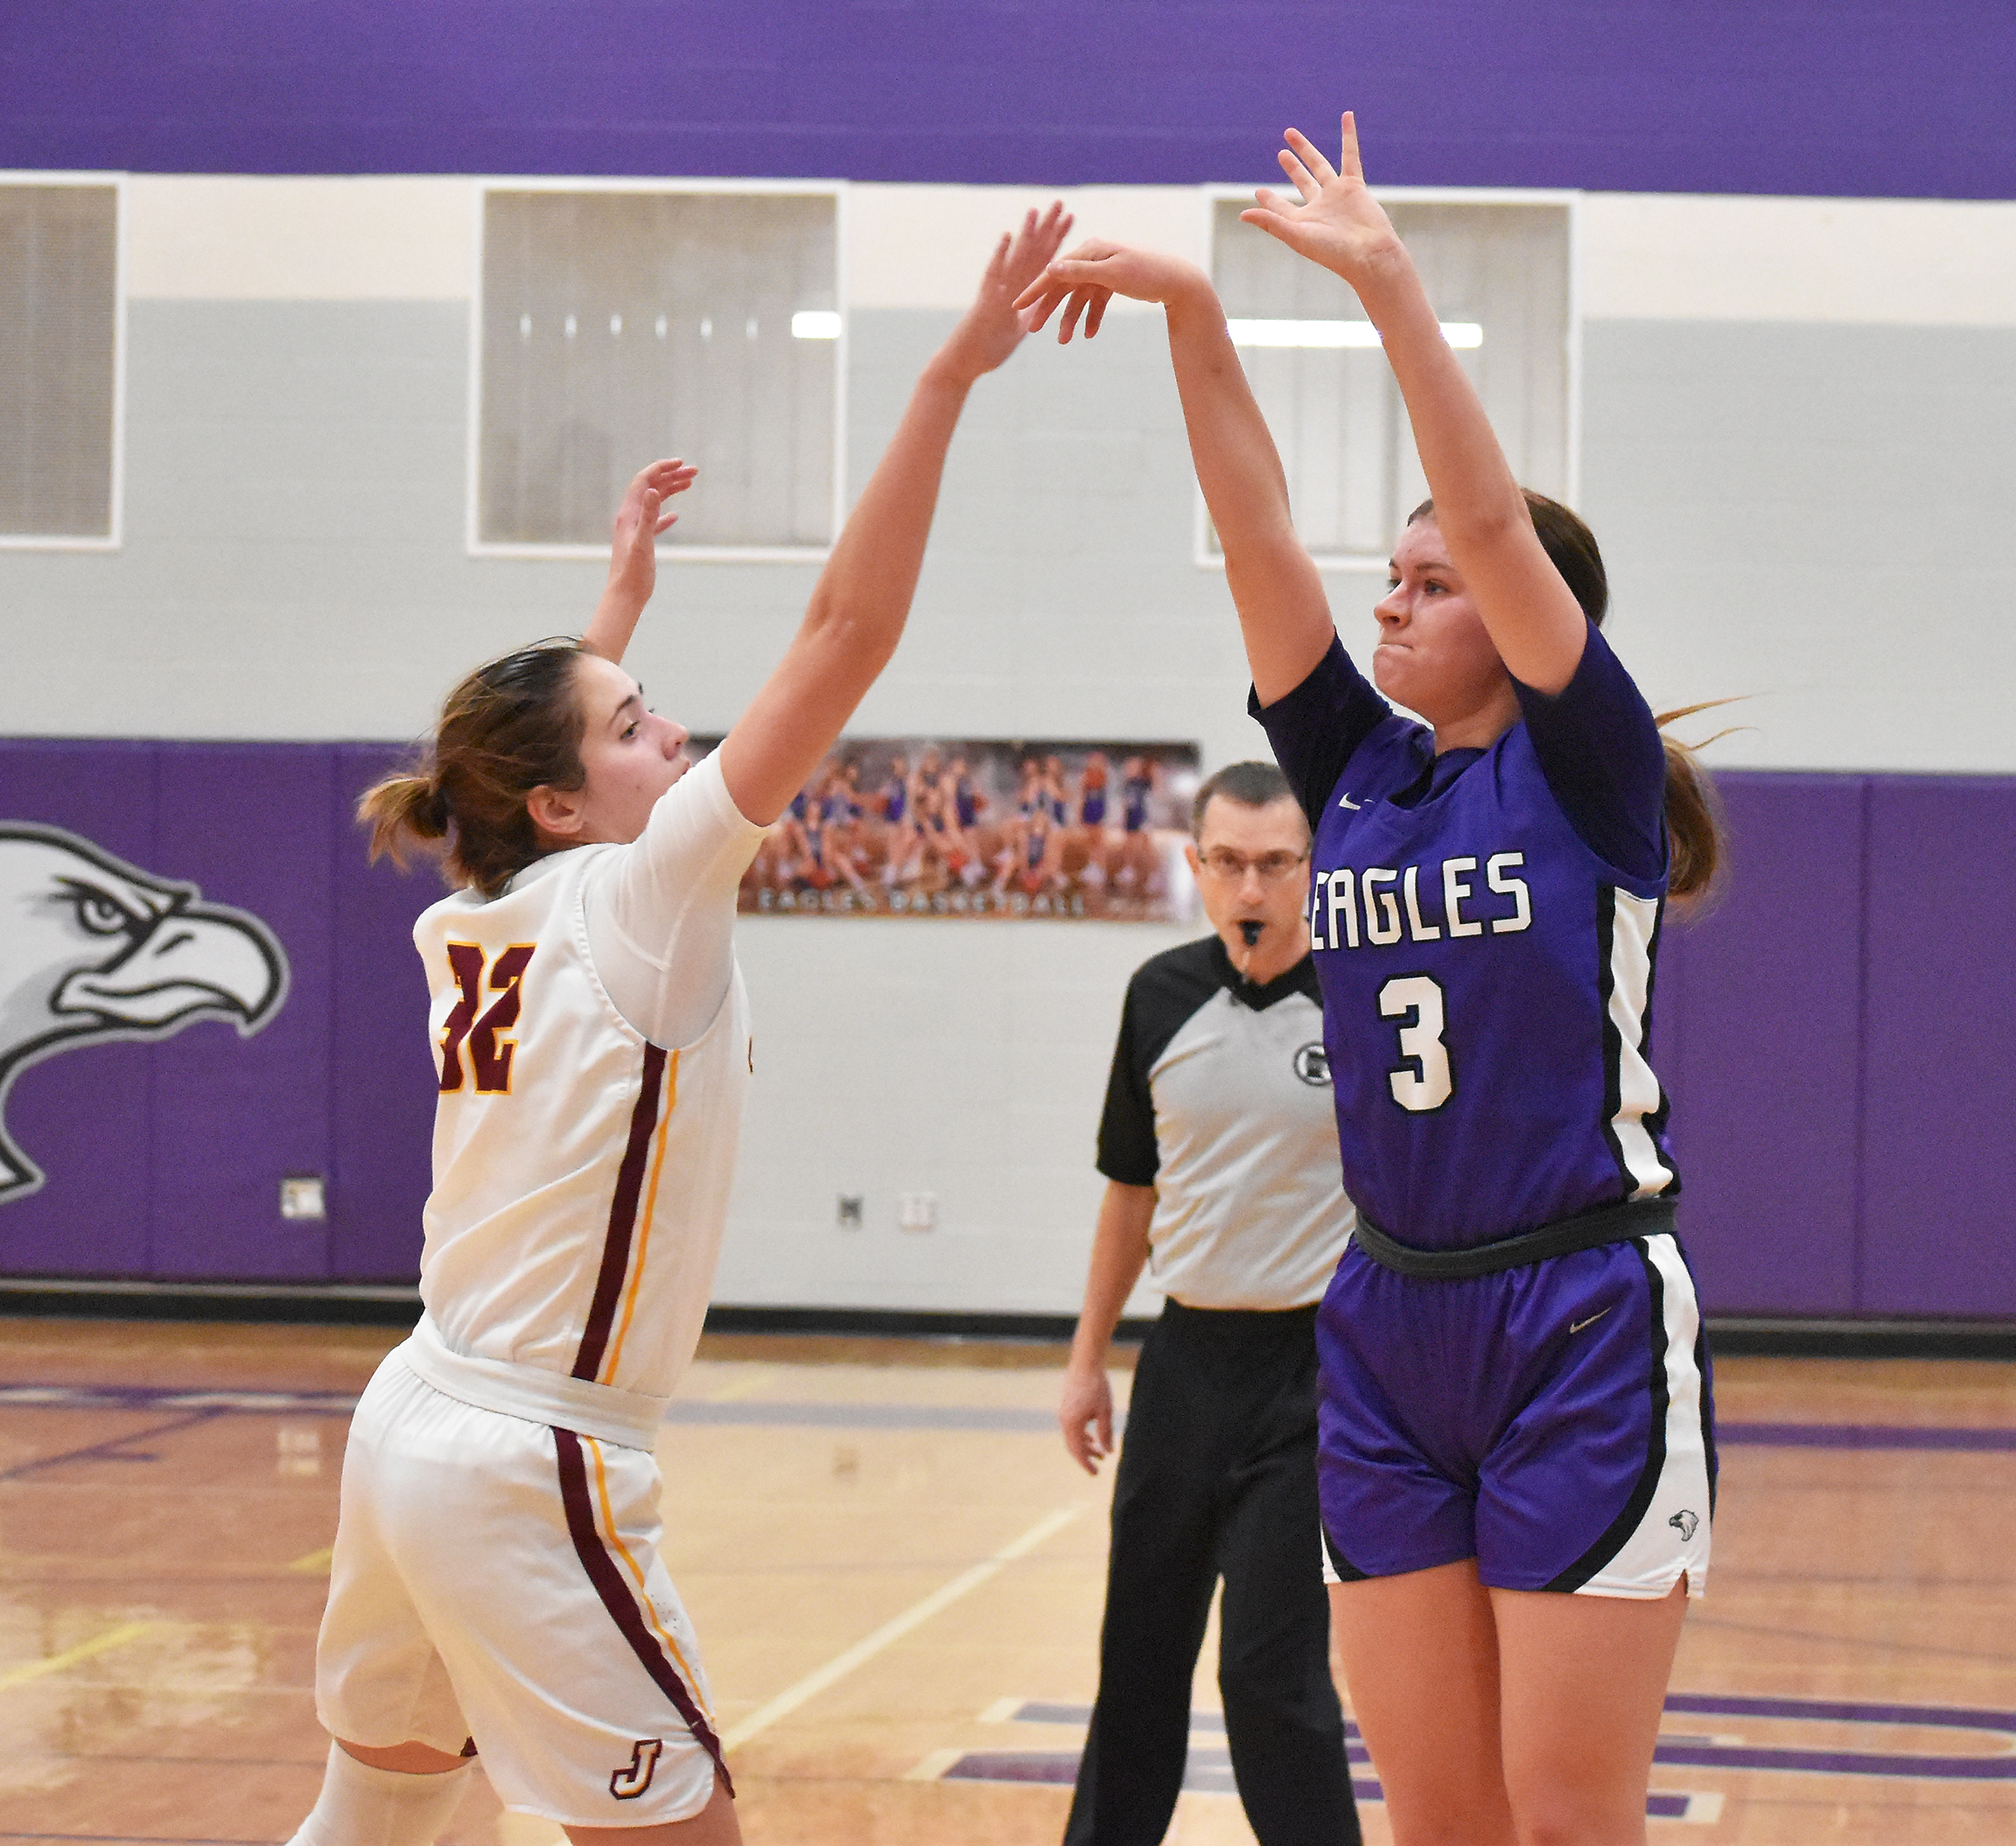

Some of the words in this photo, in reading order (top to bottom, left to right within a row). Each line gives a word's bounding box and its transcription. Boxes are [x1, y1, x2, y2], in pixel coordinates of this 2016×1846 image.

[758, 887, 878, 910] EAGLES
[887, 889, 1084, 915] BASKETBALL
[1311, 851, 1532, 951] EAGLES
[438, 940, 538, 1095] 32
[1378, 975, 1453, 1111] 3
[609, 1738, 663, 1800] J
